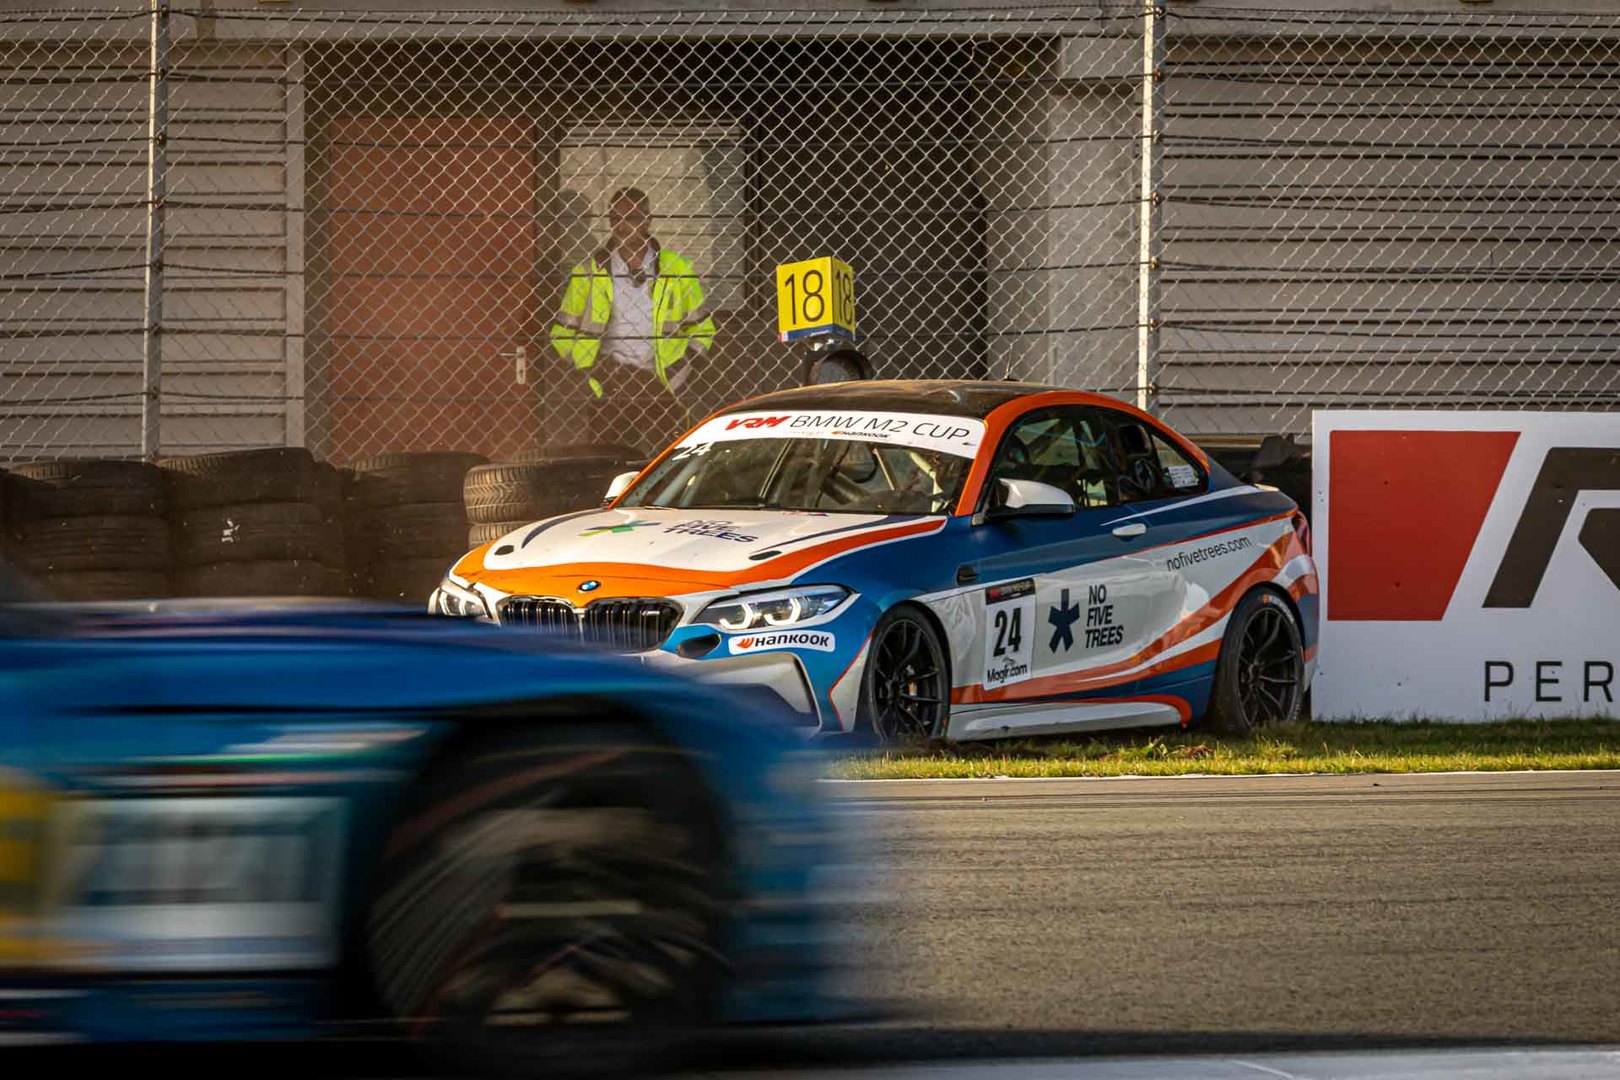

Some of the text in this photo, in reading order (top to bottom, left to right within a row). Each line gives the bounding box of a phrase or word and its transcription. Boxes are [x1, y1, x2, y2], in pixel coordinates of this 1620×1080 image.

[785, 270, 825, 325] 18
[836, 270, 853, 326] 18
[789, 415, 864, 428] BMW
[863, 418, 908, 433] M2
[912, 423, 970, 440] CUP
[663, 527, 759, 543] TREES
[1166, 536, 1253, 572] nofivetrees.com
[1088, 584, 1107, 605] NO
[1086, 604, 1113, 627] FIVE
[993, 607, 1022, 657] 24
[1085, 624, 1124, 649] TREES
[1483, 660, 1615, 702] PER
